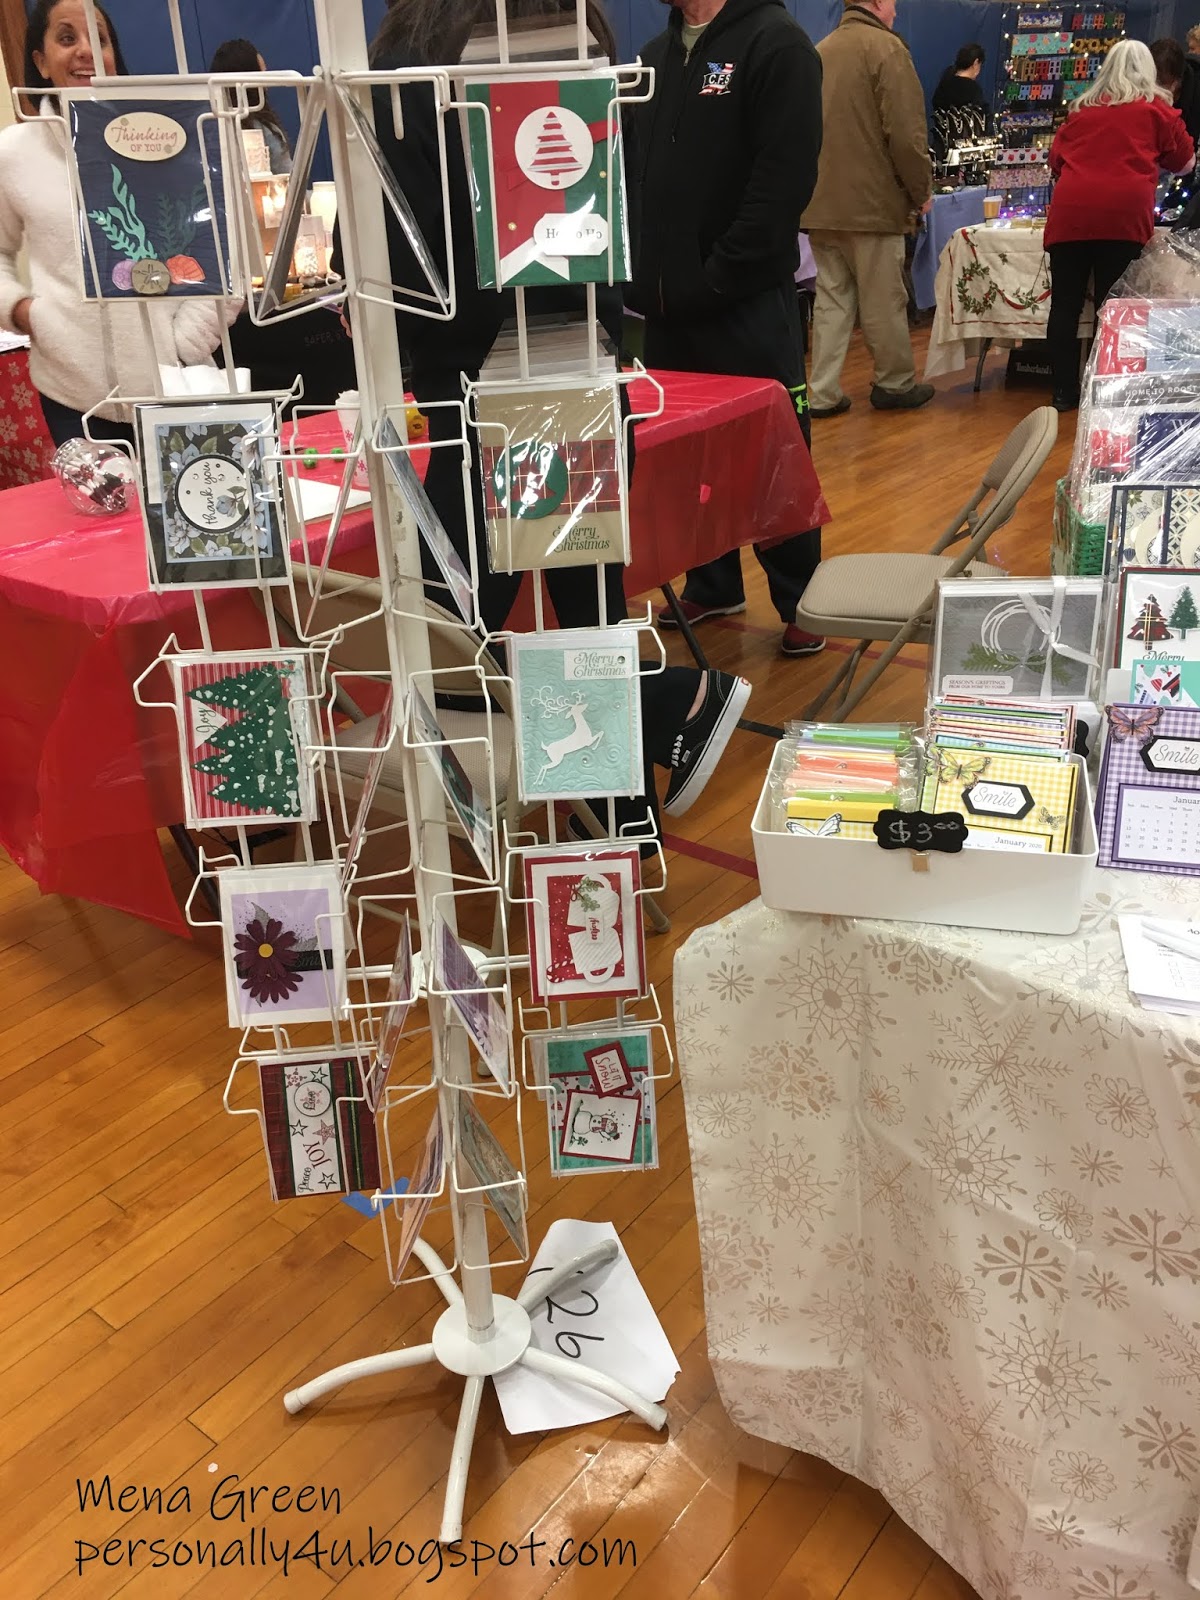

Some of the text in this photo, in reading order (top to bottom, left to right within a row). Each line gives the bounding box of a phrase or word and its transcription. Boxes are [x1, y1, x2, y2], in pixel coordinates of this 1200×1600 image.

[111, 126, 178, 147] Thinking
[131, 143, 162, 152] OF YOU
[200, 461, 219, 525] thank you
[573, 651, 617, 667] Merry
[573, 664, 627, 678] Christmas
[1154, 744, 1199, 765] Smile
[973, 786, 1017, 808] Smile
[994, 836, 1027, 848] January
[303, 1141, 332, 1169] JOY
